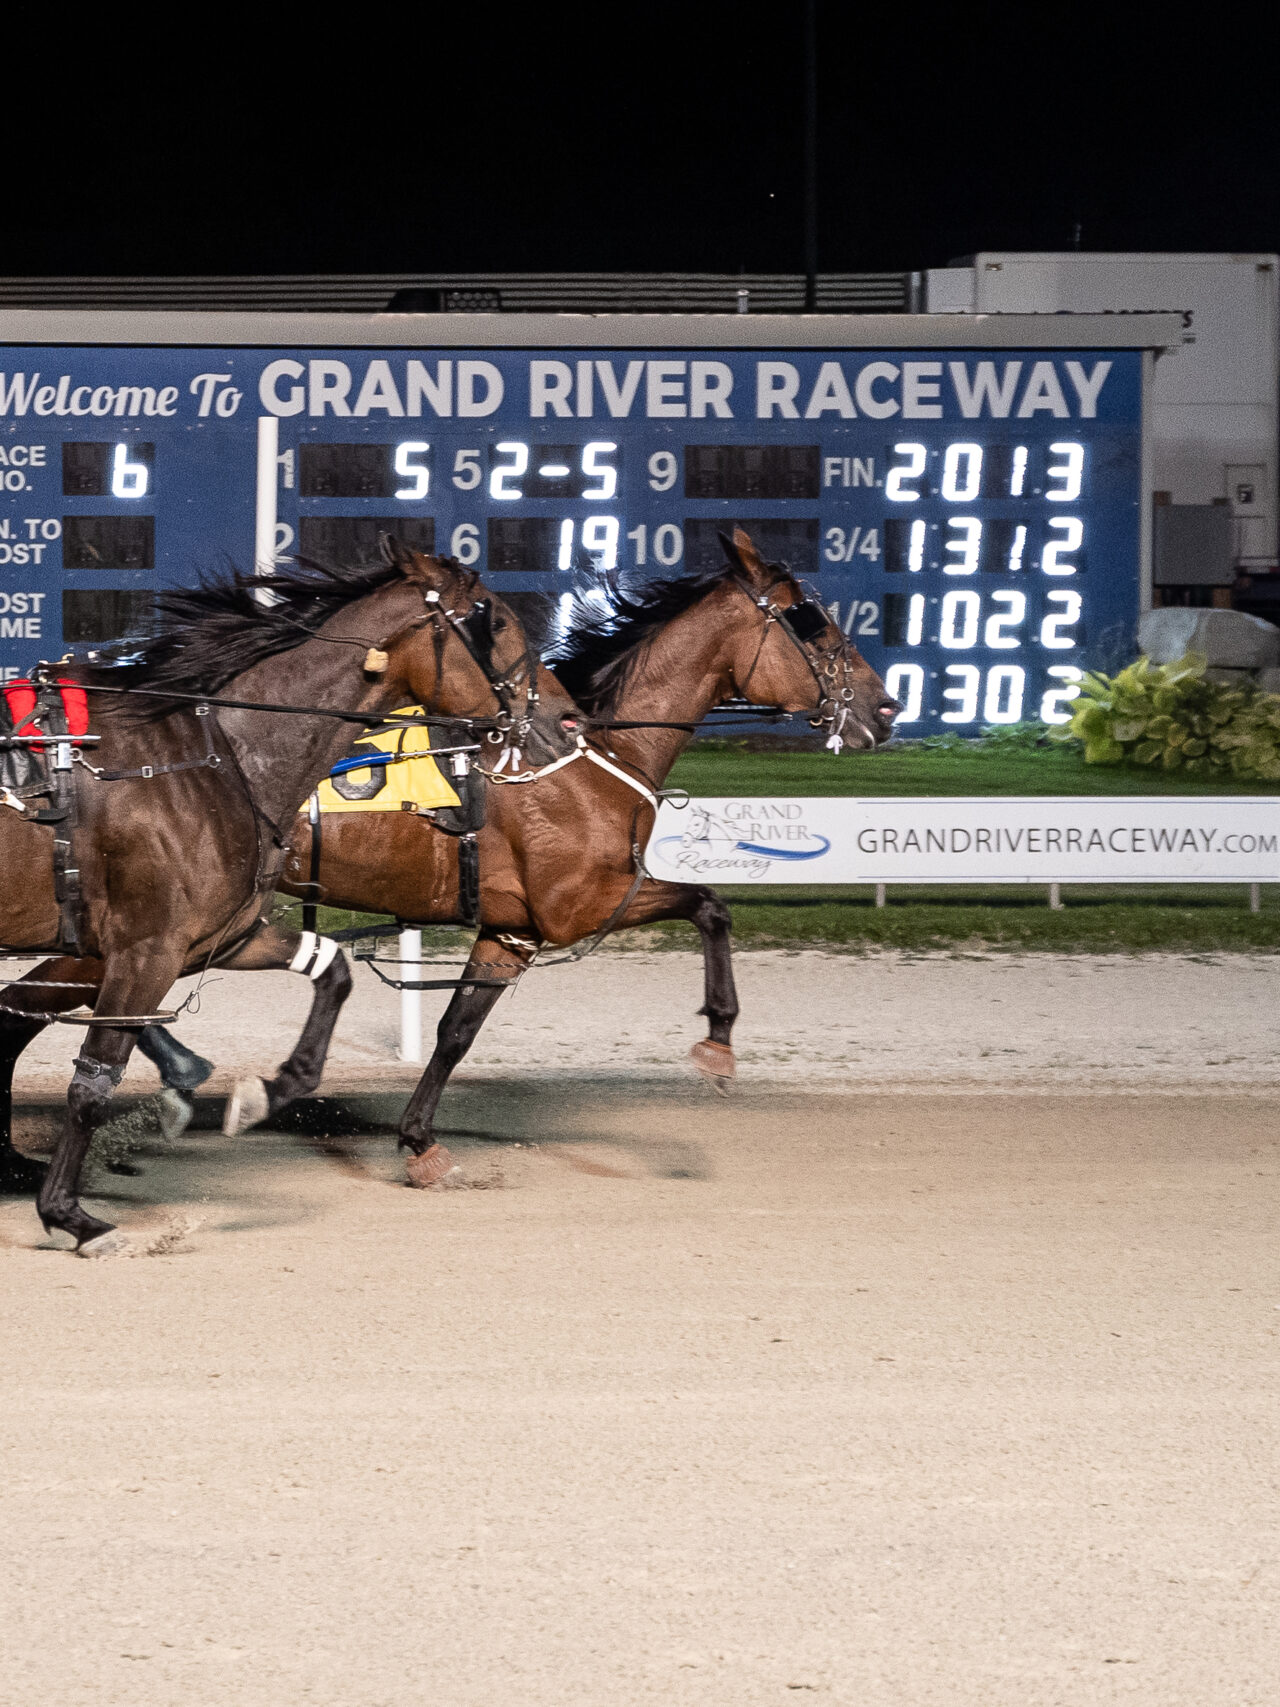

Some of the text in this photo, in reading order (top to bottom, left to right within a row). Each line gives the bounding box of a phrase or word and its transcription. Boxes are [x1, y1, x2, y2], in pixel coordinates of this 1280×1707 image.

[190, 373, 243, 418] To
[259, 359, 505, 418] GRAND
[530, 360, 734, 419] RIVER
[756, 361, 1113, 420] RACEWAY
[112, 442, 149, 498] 6
[394, 442, 430, 500] 5
[452, 450, 482, 490] 5
[648, 451, 677, 491] 9
[824, 457, 883, 488] FIN.
[26, 519, 62, 540] TO
[451, 523, 481, 565] 6
[558, 516, 619, 570] 19
[627, 524, 684, 565] 10
[824, 527, 881, 562] 3/4
[725, 802, 803, 820] GRAND
[750, 823, 812, 841] RIVER
[676, 851, 773, 878] Raceway
